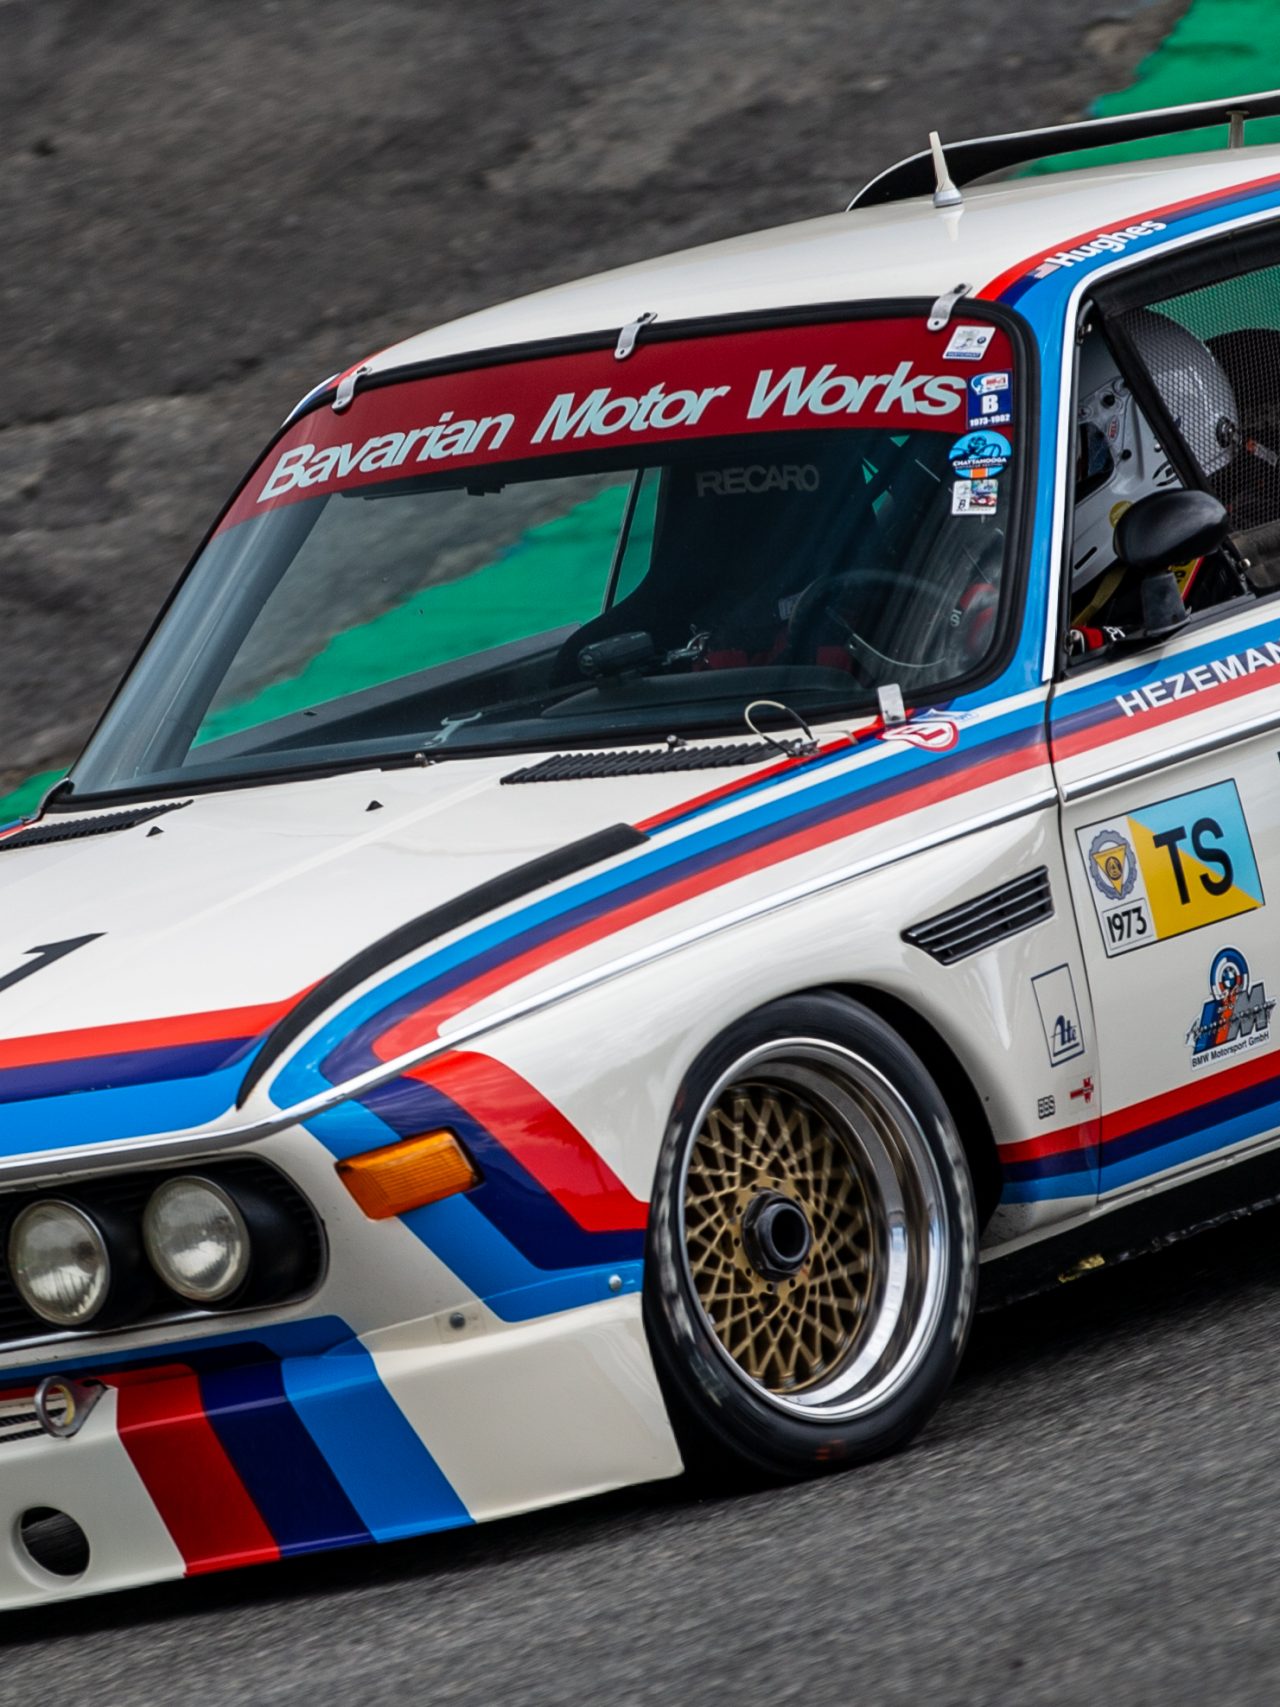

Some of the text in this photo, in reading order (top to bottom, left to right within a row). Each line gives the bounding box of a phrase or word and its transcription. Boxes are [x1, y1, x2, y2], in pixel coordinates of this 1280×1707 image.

[1045, 220, 1167, 268] Hughes
[982, 394, 999, 415] B
[257, 361, 968, 503] Bavarian Motor Works
[695, 464, 820, 498] RECARO
[1153, 817, 1234, 905] TS
[1106, 906, 1148, 943] 1973
[1192, 1031, 1270, 1068] BMW Motorsport GmbH
